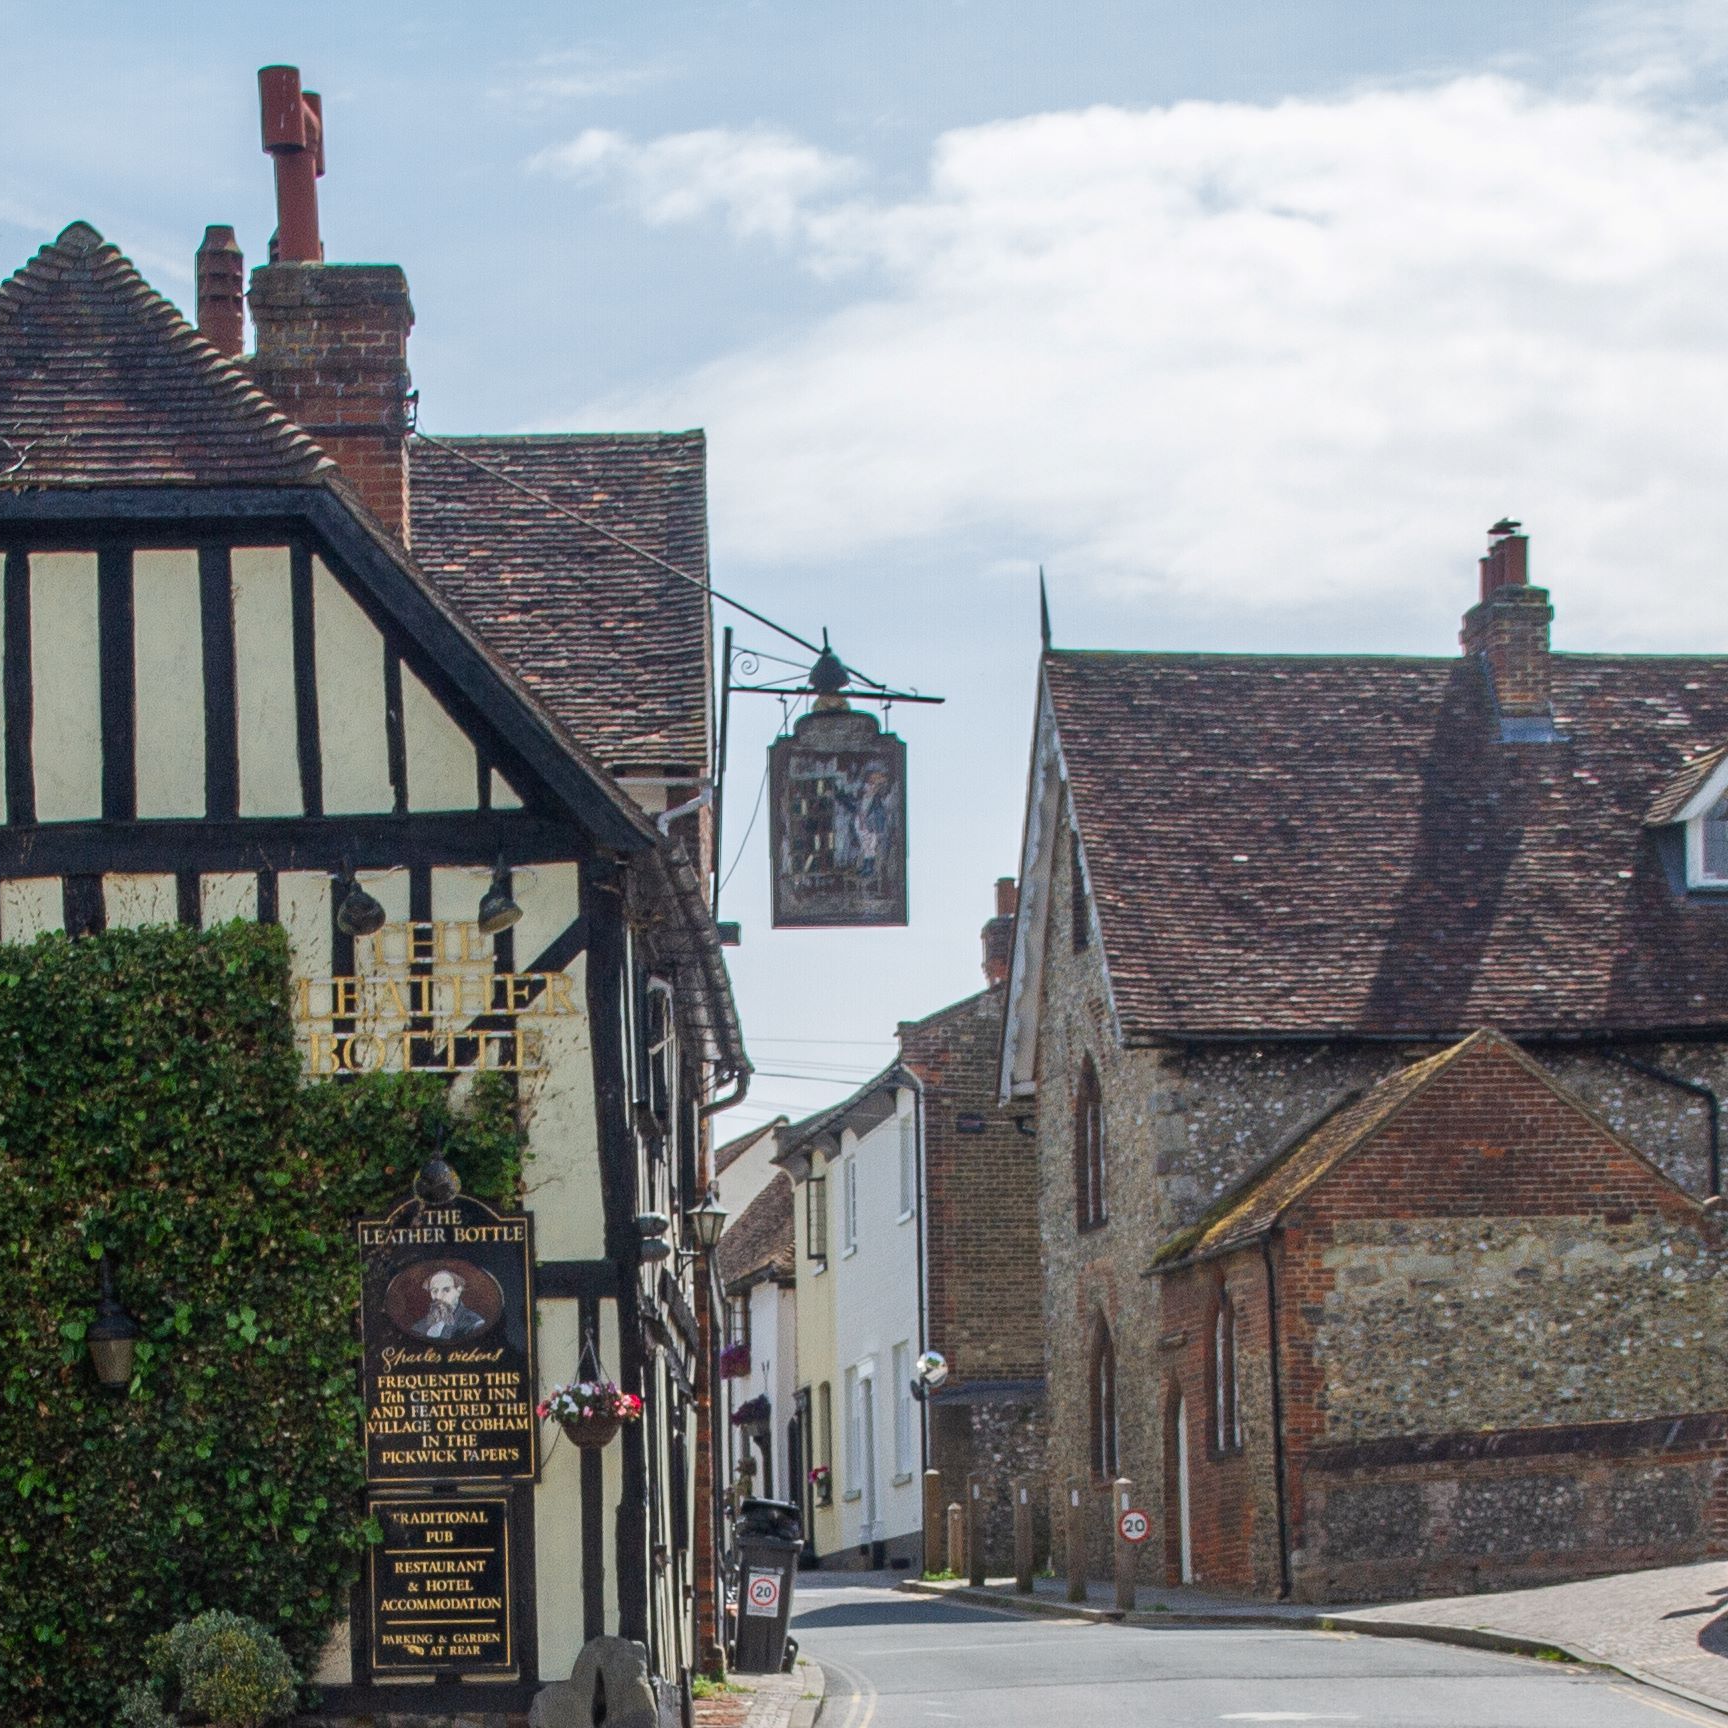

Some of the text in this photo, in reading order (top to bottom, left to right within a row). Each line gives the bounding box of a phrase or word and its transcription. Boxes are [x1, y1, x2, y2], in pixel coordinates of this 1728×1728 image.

[375, 921, 495, 963] THE
[298, 973, 577, 1020] LEATHER
[309, 1030, 545, 1075] BOTTLE
[424, 1210, 462, 1225] THE
[363, 1226, 524, 1245] LEATHER BOTTLE
[377, 1372, 520, 1389] FREQUENTED THIS
[380, 1388, 517, 1404] 17th CENTURY INN
[371, 1402, 528, 1419] AND FEATURED THE
[367, 1418, 529, 1434] VILLAGE OF COBHAM
[422, 1434, 478, 1448] IN THE
[382, 1448, 520, 1464] PICKWICK PAPER'S
[392, 1511, 489, 1525] TRADITIONAL
[1124, 1518, 1146, 1532] 20
[426, 1531, 454, 1543] PUB
[394, 1560, 486, 1574] RESTAURANT
[407, 1579, 474, 1592] & HOTEL
[755, 1585, 772, 1599] 20
[380, 1597, 502, 1611] ACCOMMODATION
[382, 1633, 501, 1645] PARKING & GARDEN
[430, 1645, 481, 1656] AT REAR
